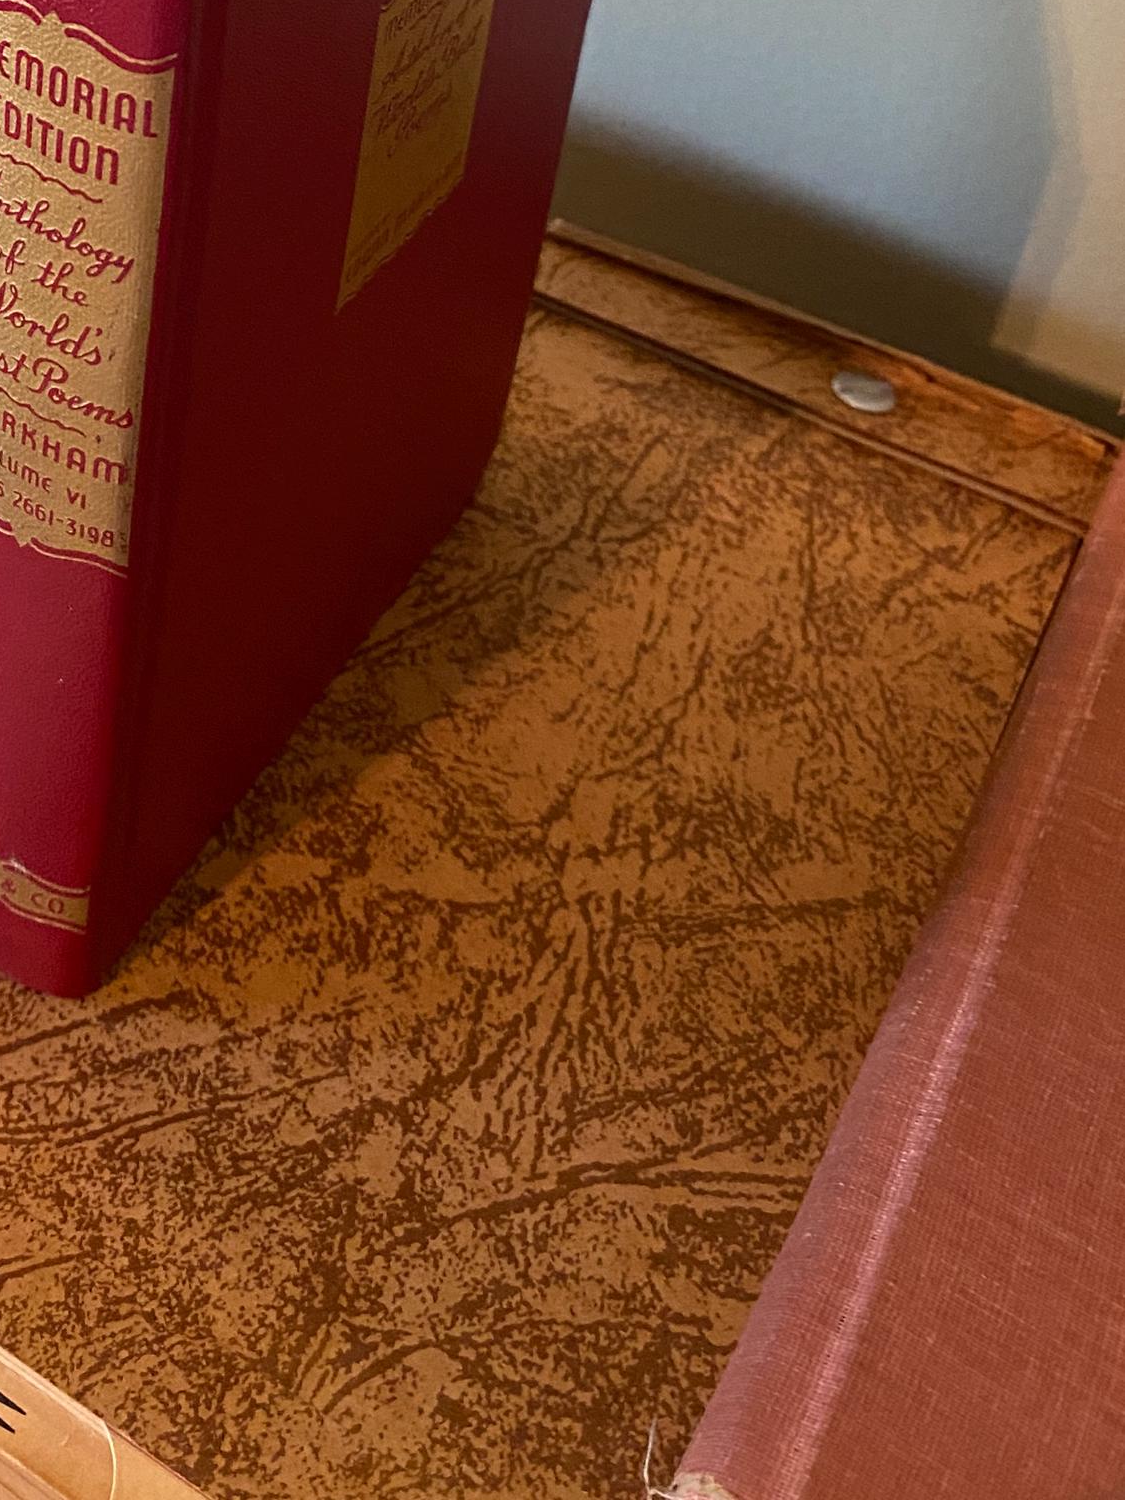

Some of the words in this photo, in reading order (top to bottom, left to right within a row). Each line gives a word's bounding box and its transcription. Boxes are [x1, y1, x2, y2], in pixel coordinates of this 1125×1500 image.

[31, 260, 90, 308] the
[25, 356, 134, 429] Poems
[11, 489, 115, 549] 2661-3198
[65, 486, 87, 511] VI
[30, 893, 65, 914] CO
